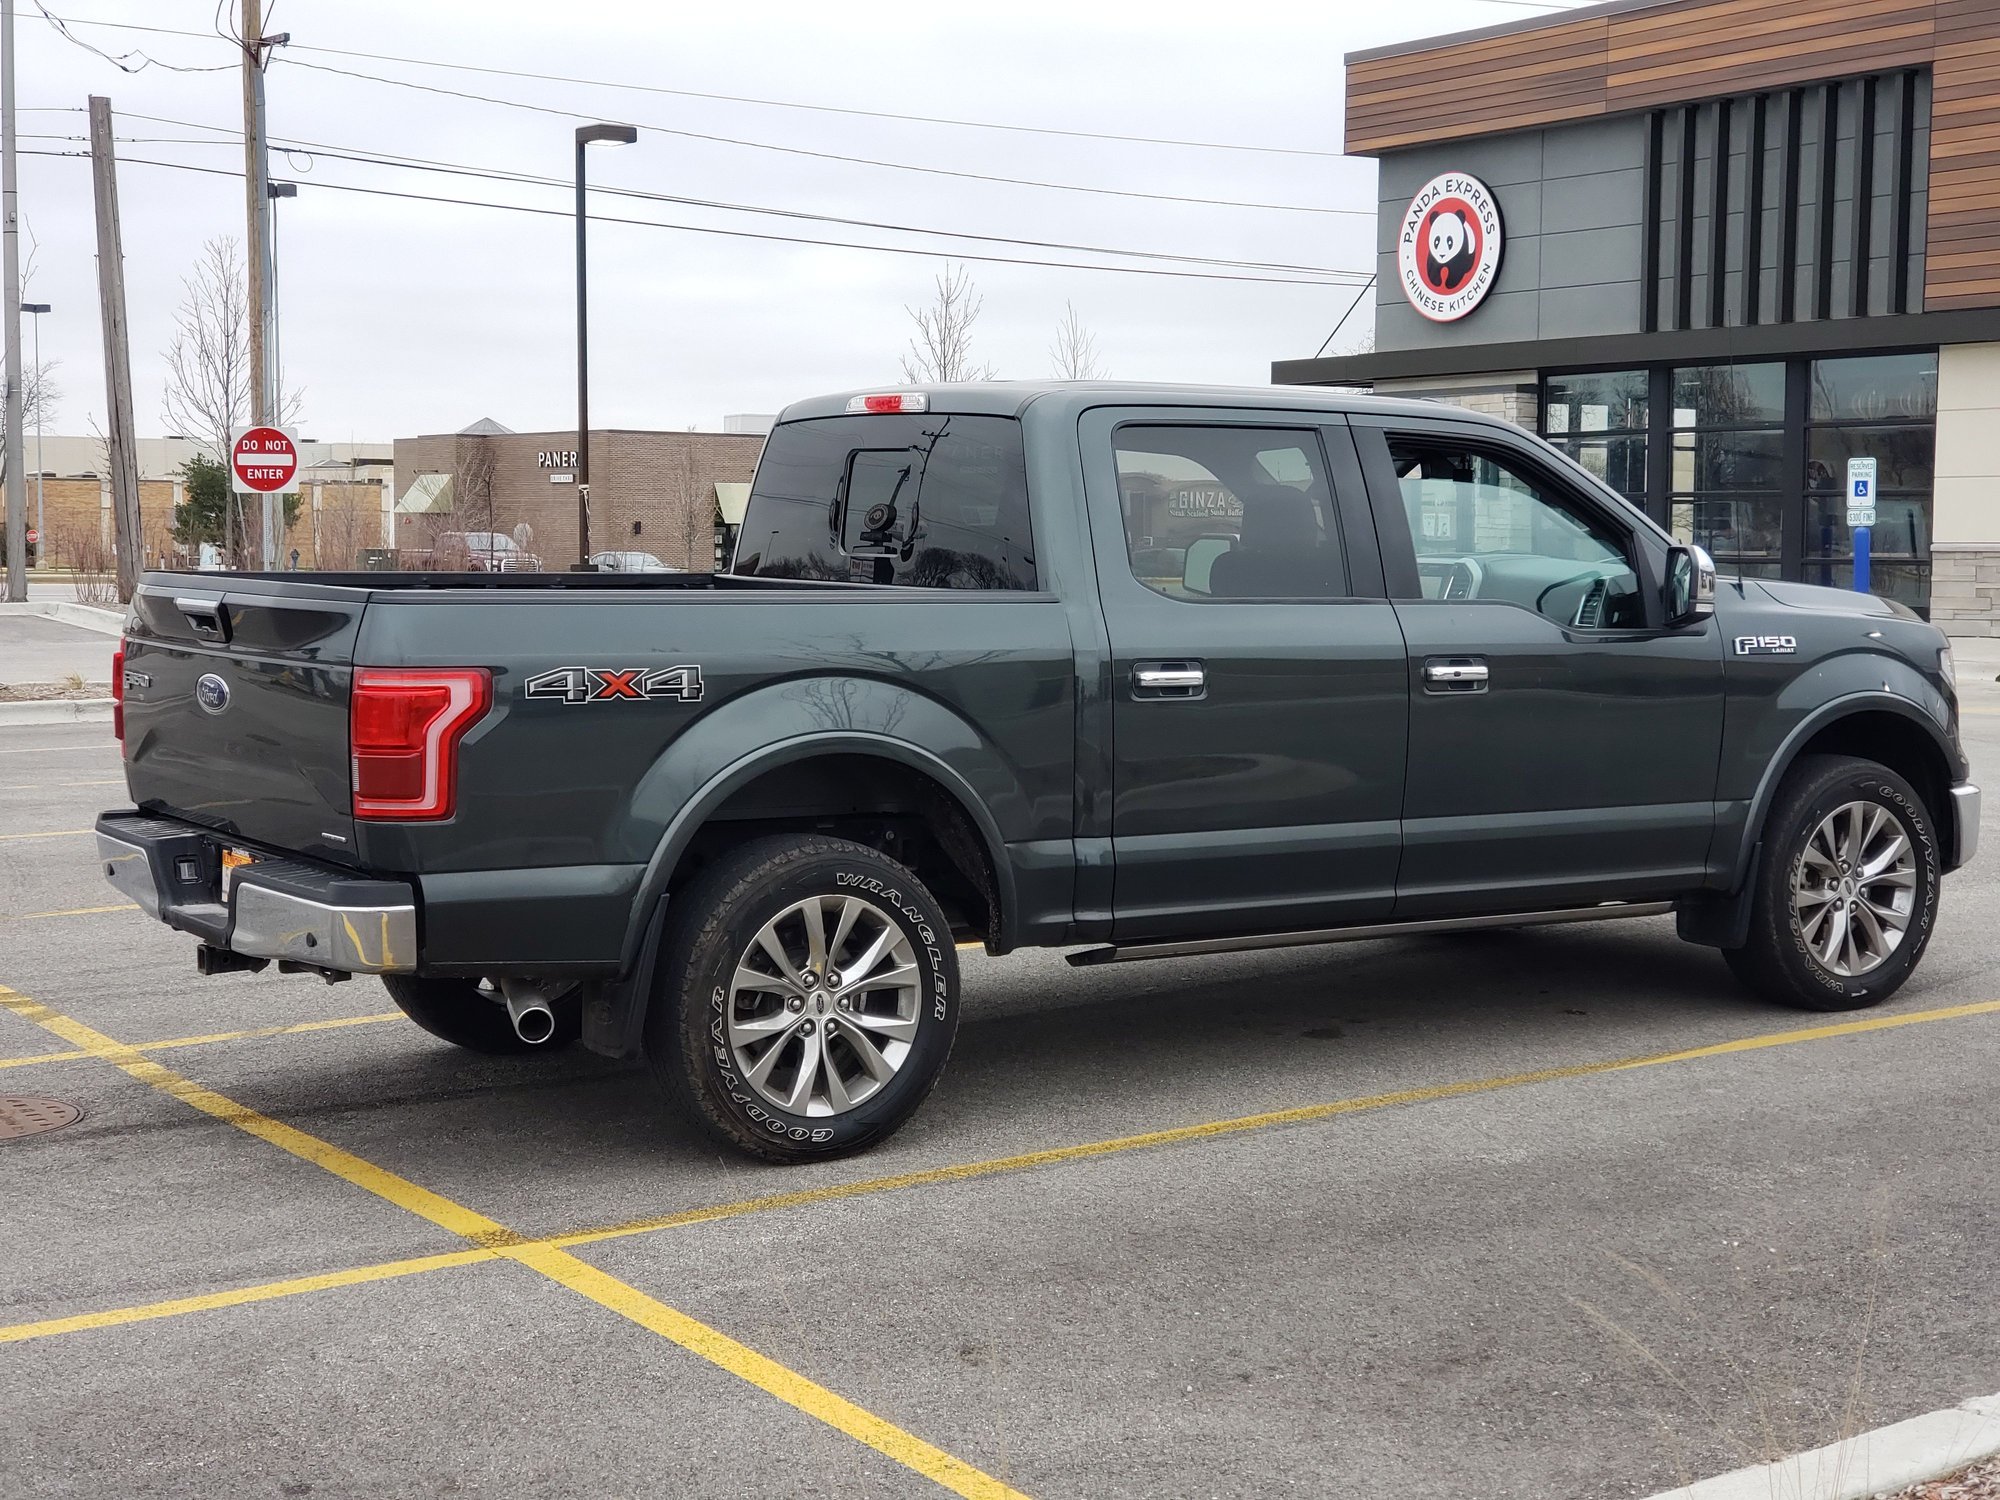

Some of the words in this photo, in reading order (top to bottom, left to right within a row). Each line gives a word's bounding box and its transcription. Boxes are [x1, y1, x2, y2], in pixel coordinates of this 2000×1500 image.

[1404, 186, 1441, 243] PANDA
[1446, 179, 1495, 235] EXPRESS
[1406, 269, 1444, 313] CHINESE
[1450, 263, 1491, 313] KITCHEN
[242, 440, 258, 451] DO
[265, 440, 288, 451] NOT
[538, 451, 580, 468] PANER
[247, 469, 284, 480] ENTER
[1179, 491, 1226, 509] GINZA
[1733, 636, 1797, 655] F150
[1879, 785, 1937, 931] GOODYEAR
[836, 872, 948, 1021] WRANGLER
[710, 985, 835, 1142] GOODYEAR
